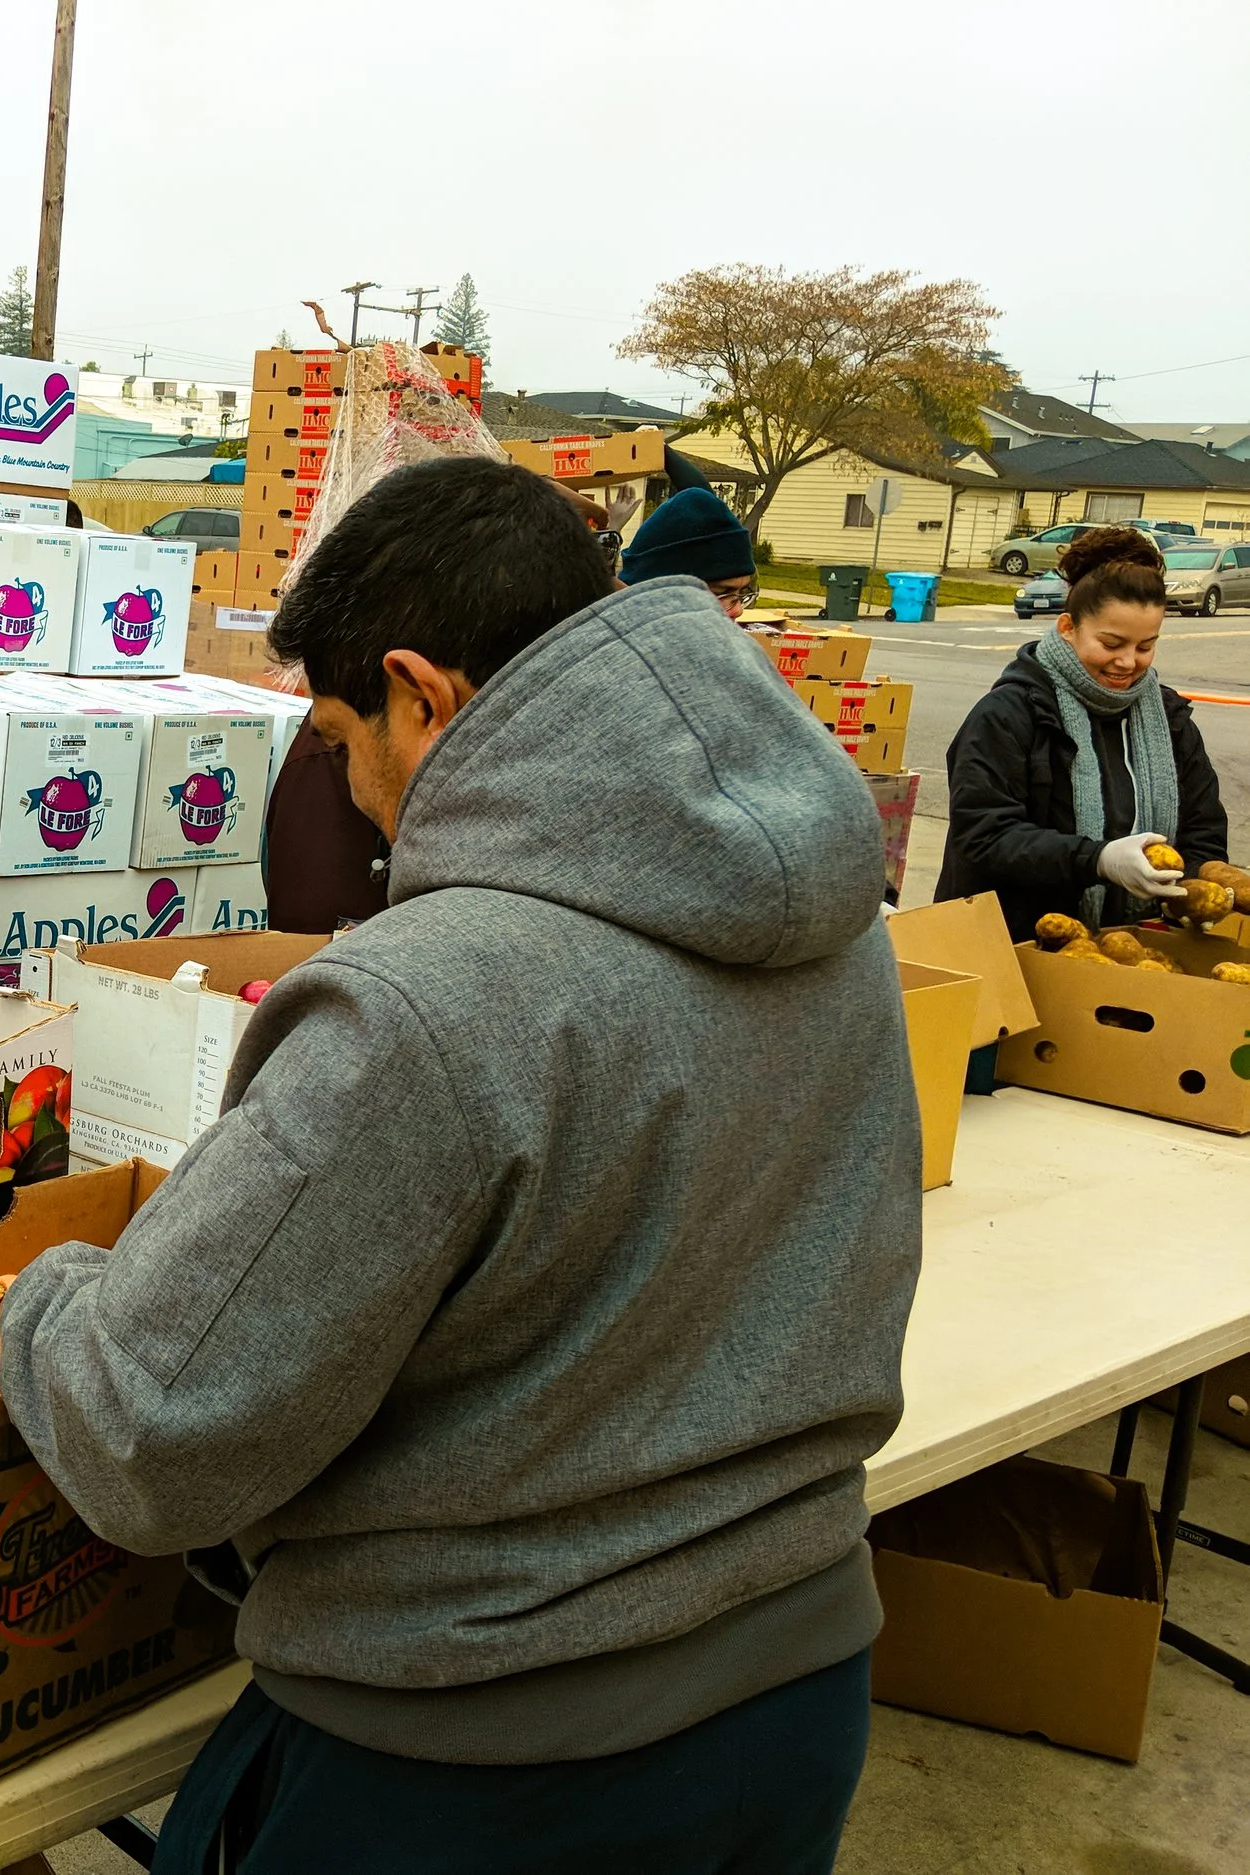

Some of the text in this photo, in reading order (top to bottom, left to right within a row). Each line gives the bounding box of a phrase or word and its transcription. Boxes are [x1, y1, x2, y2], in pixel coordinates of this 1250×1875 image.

[2, 455, 16, 466] Blue
[17, 457, 46, 469] Mountain
[47, 460, 70, 474] Country
[554, 458, 591, 471] HMC
[32, 585, 42, 606] 4
[151, 592, 160, 613] 4
[6, 616, 36, 634] FORE
[113, 617, 154, 639] LE FORE
[778, 657, 808, 671] HMC
[839, 707, 864, 720] HMC
[88, 774, 99, 799] 4
[222, 771, 233, 793] 4
[40, 805, 91, 831] LE FORE
[181, 801, 227, 825] LE FORE
[98, 975, 160, 1000] NET WT. 28 LBS
[204, 1034, 218, 1046] SIZE
[198, 1046, 208, 1054] 120
[197, 1057, 206, 1066] 100
[199, 1069, 205, 1077] 90
[90, 1083, 98, 1091] CA
[99, 1086, 115, 1096] 3370
[130, 1095, 142, 1105] LOT
[92, 1075, 151, 1098] FALL FIESTA PLUM
[198, 1081, 205, 1089] 80
[197, 1092, 203, 1101] 70
[195, 1104, 202, 1112] 65
[70, 1117, 168, 1154] GSBURG ORCHARDS
[193, 1127, 200, 1135] 55
[84, 1140, 107, 1153] PRODUCE
[1177, 1528, 1205, 1544] ETIME
[16, 1541, 114, 1617] FARMS
